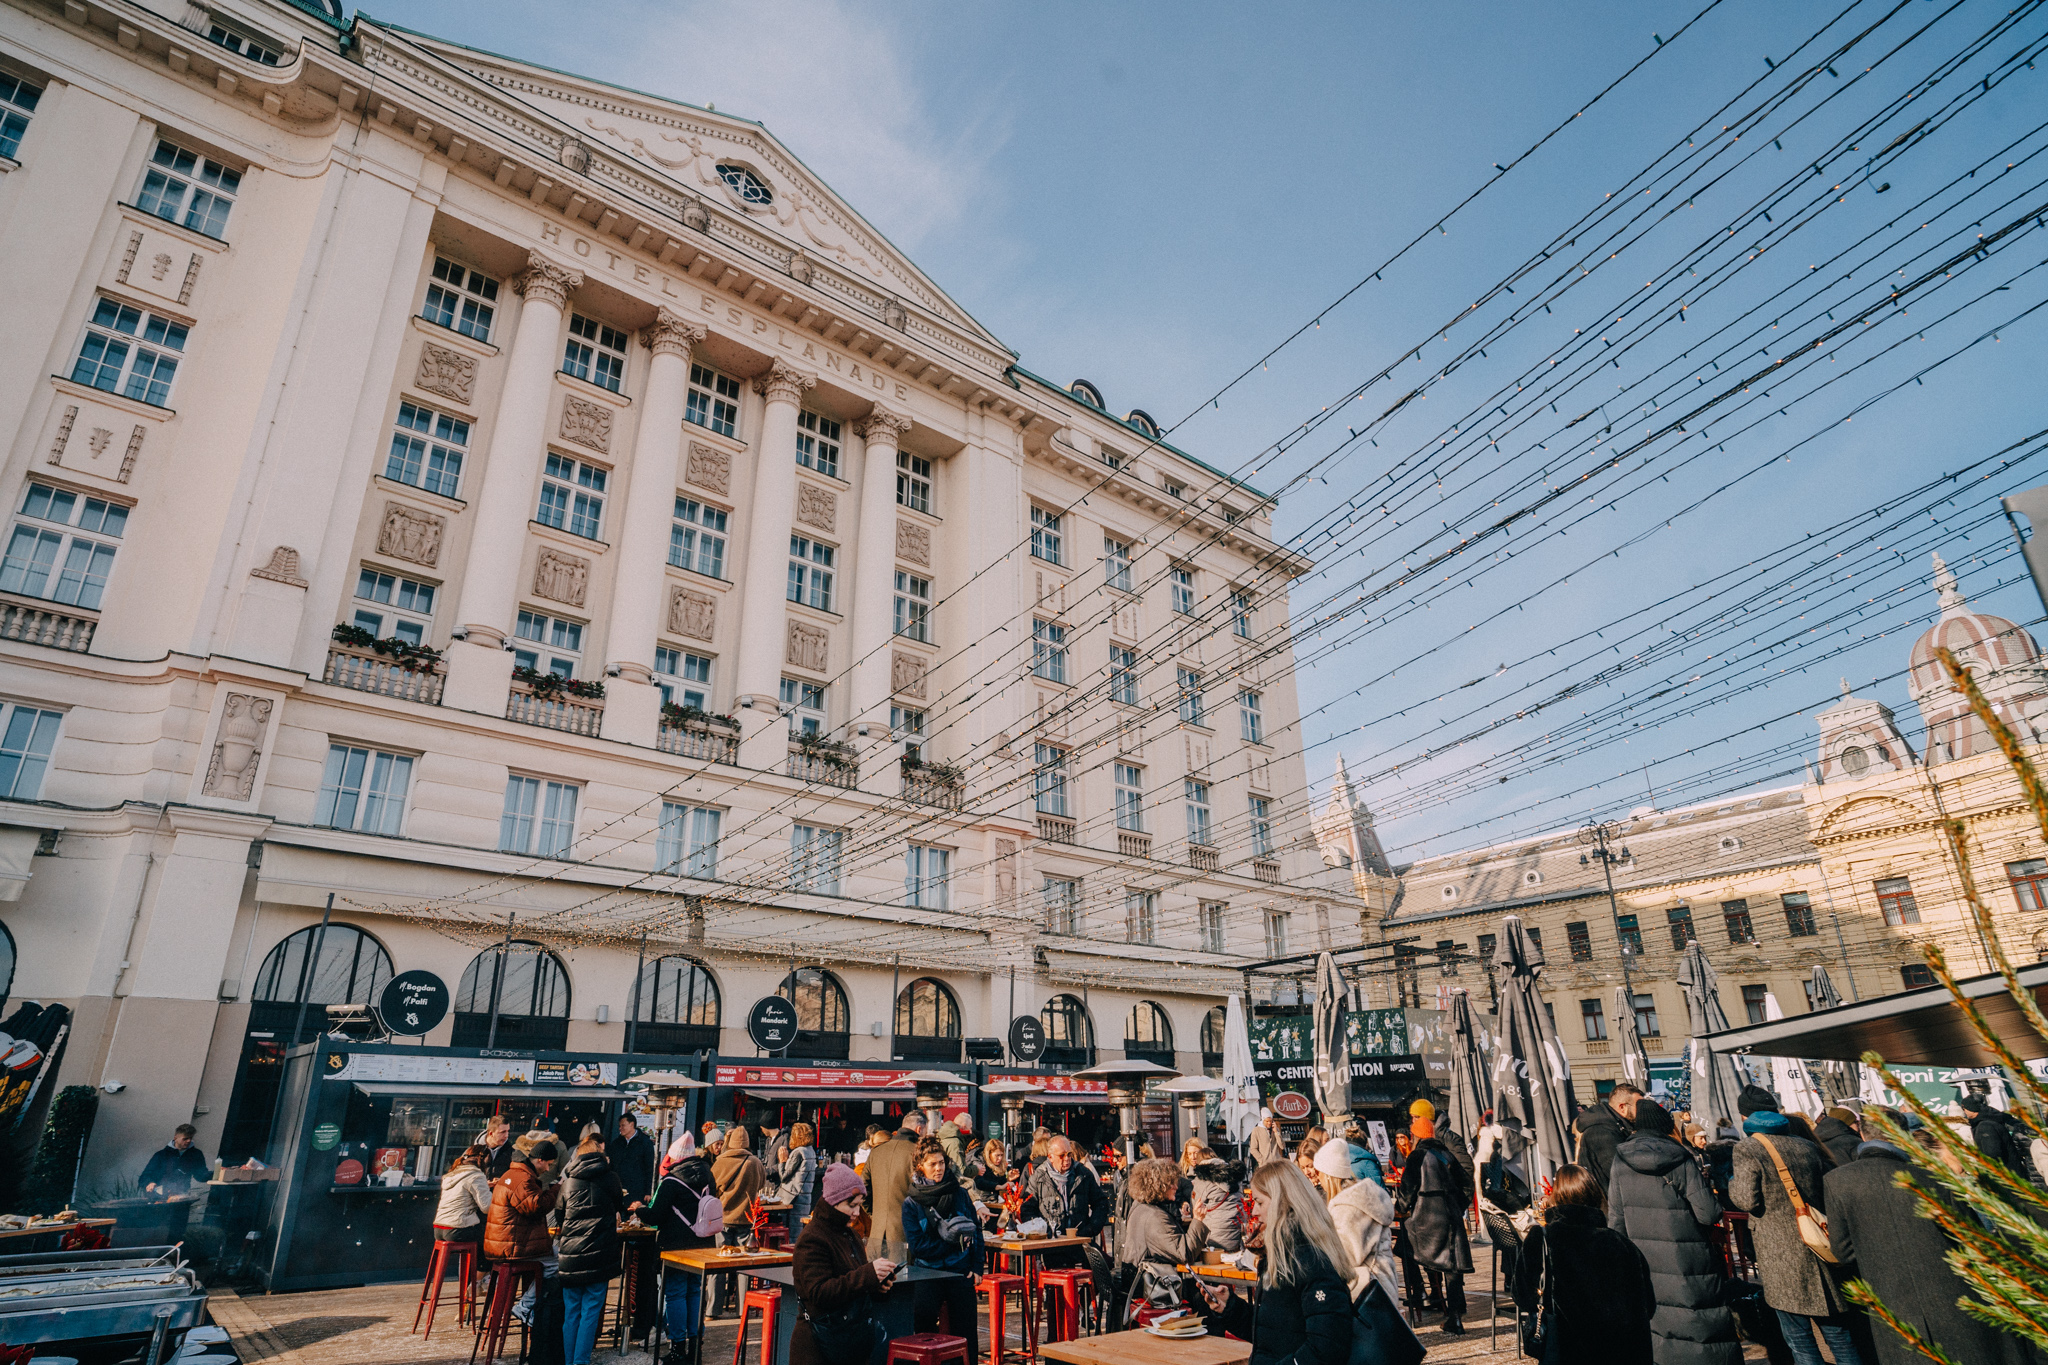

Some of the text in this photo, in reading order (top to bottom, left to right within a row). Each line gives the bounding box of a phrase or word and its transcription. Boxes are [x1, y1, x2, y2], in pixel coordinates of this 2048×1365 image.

[541, 221, 908, 401] HOTEL ESPLANADE
[716, 1067, 737, 1075] PONUDA
[1277, 1065, 1314, 1080] CENTR
[717, 1075, 735, 1083] HRANE
